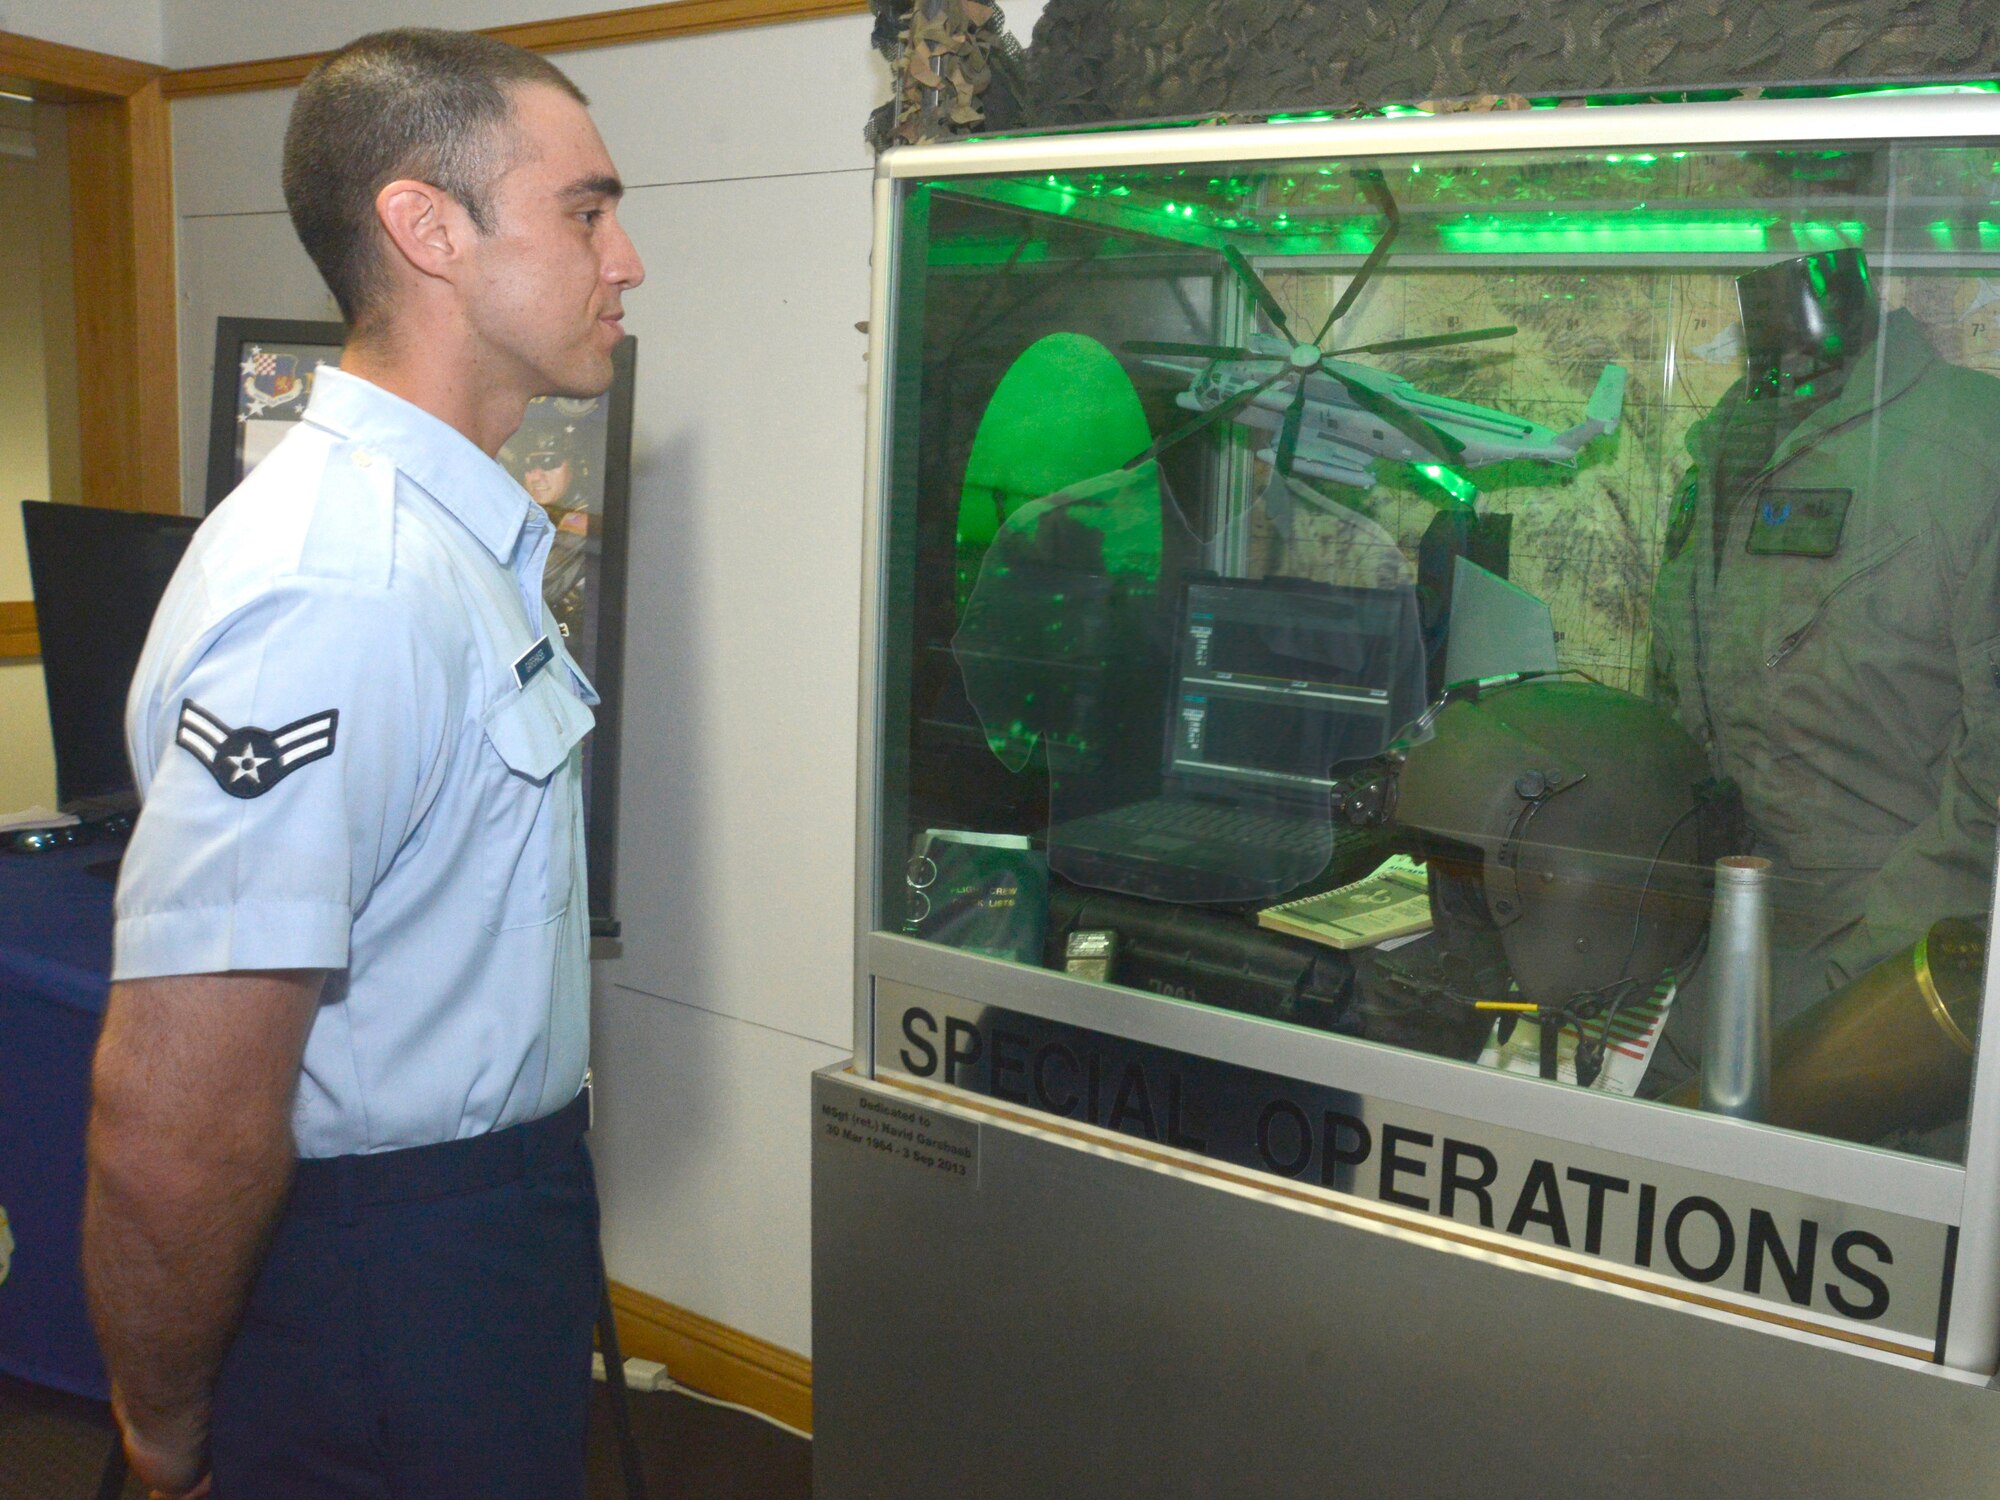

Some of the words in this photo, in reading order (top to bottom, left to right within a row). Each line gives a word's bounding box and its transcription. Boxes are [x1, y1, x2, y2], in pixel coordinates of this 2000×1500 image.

[822, 1103, 849, 1123] MSgt
[859, 1097, 915, 1122] Dedicated
[918, 1115, 931, 1128] to
[842, 1127, 864, 1144] Mar
[912, 1149, 935, 1168] Sep
[936, 1157, 967, 1177] 2013
[900, 1006, 1209, 1152] SPECIAL
[1255, 1100, 1894, 1321] OPERATIONS
